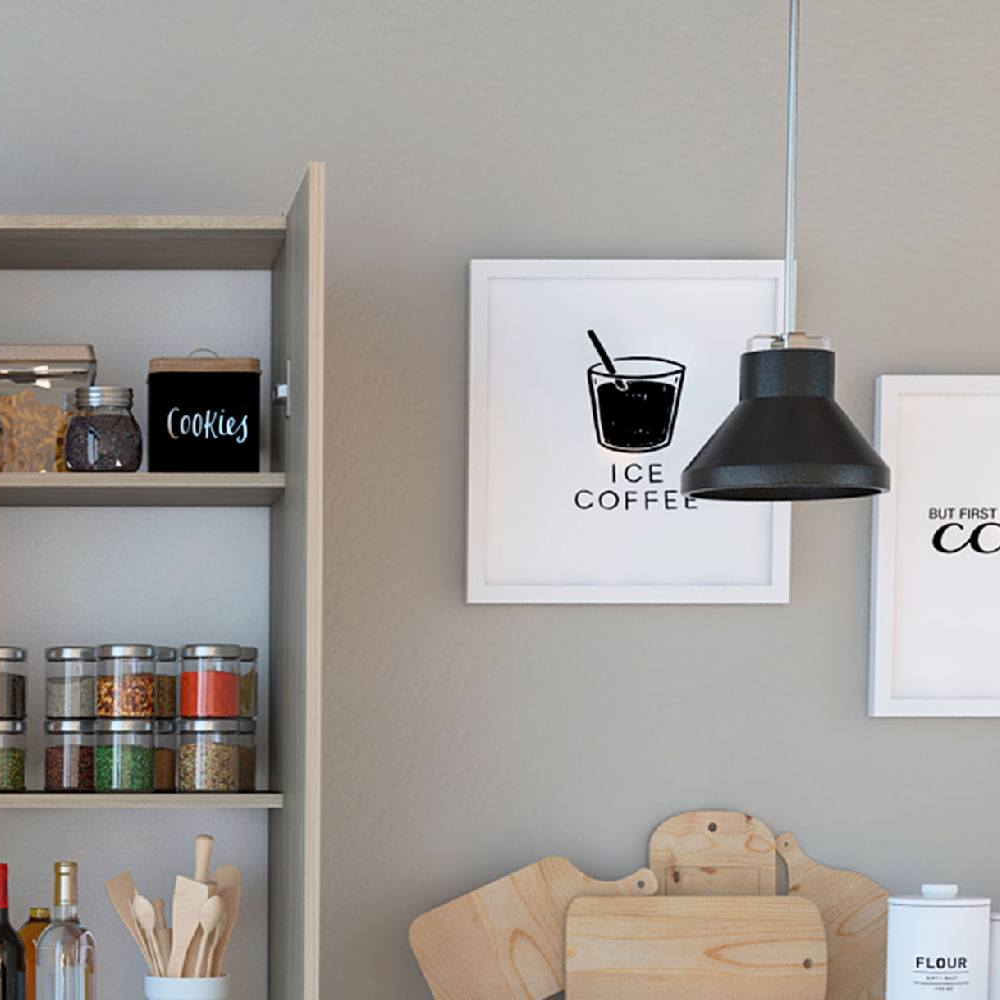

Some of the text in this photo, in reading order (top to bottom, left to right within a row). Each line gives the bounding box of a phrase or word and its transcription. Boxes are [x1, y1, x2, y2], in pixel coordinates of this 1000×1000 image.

[166, 406, 248, 444] Cookies
[611, 463, 664, 483] ICE
[574, 489, 698, 510] COFFEE
[928, 507, 997, 520] BUT FIRST
[915, 956, 968, 969] FLOUR
